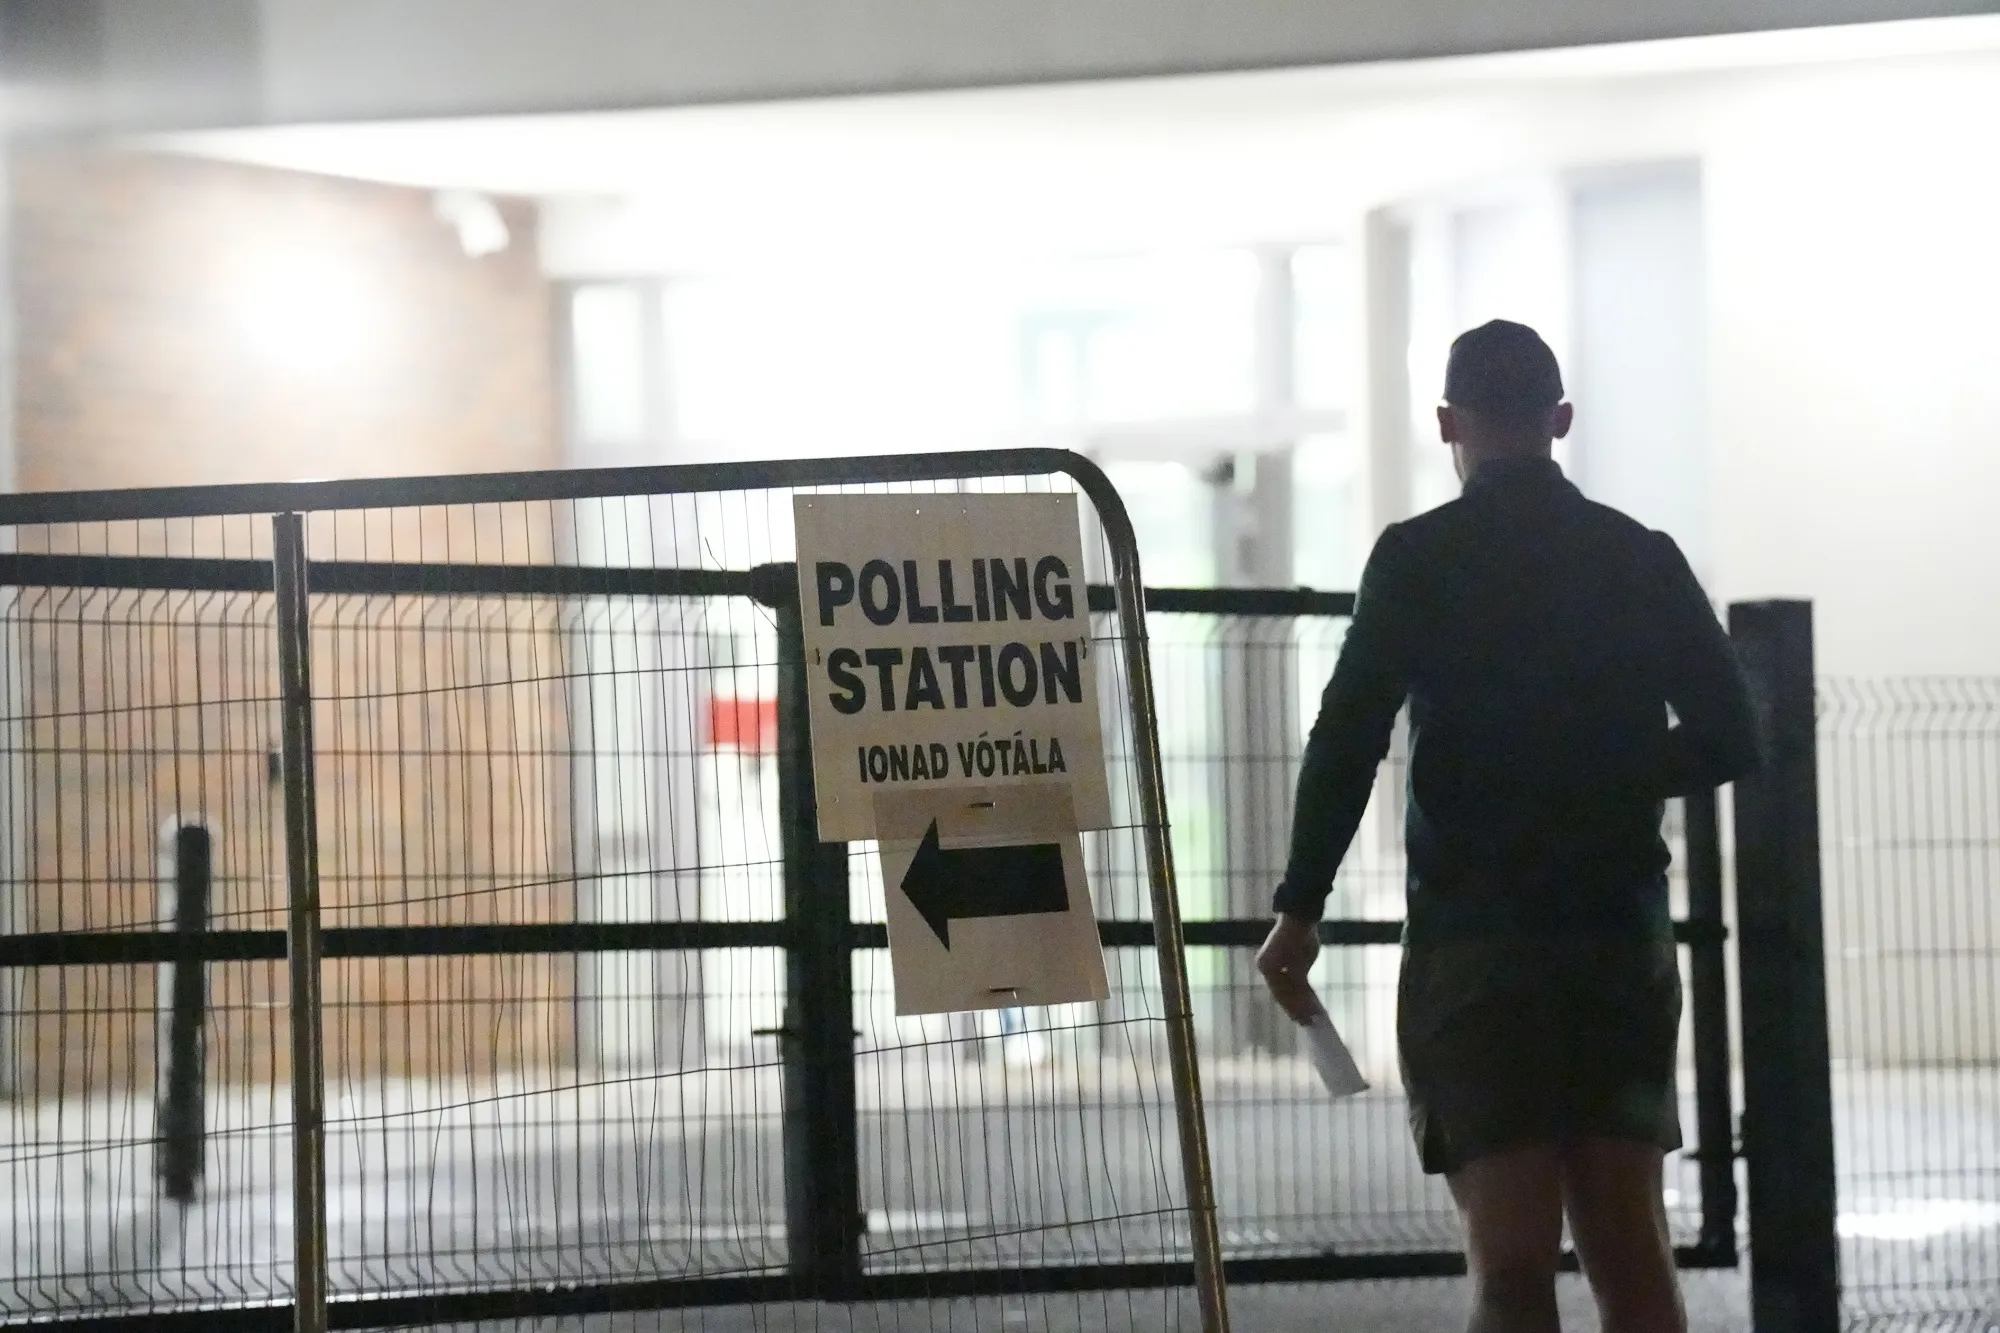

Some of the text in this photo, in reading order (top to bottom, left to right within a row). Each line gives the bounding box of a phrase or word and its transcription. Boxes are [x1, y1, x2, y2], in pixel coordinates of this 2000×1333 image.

[816, 555, 1075, 626] POLLING
[827, 641, 1083, 715] STATION
[858, 730, 1067, 783] IONAD VÓTÁLA
